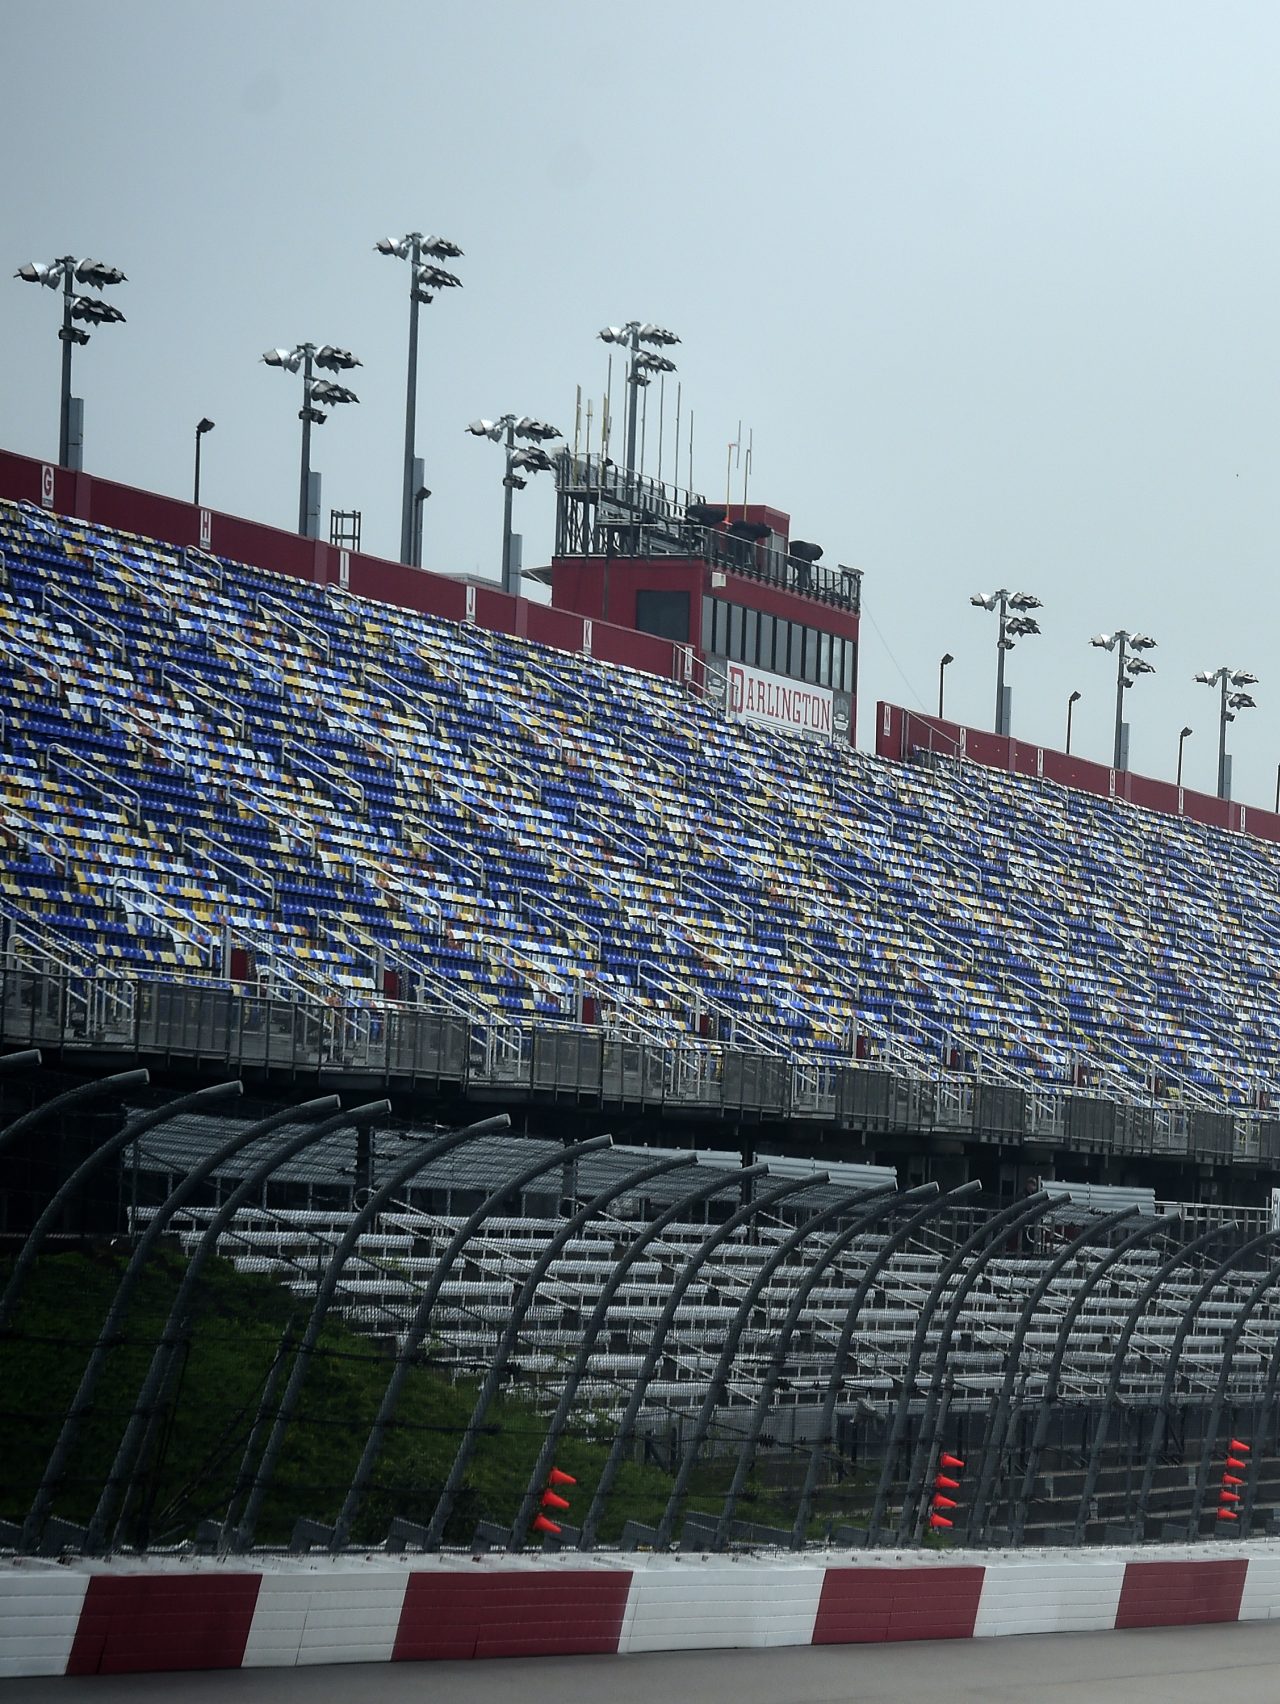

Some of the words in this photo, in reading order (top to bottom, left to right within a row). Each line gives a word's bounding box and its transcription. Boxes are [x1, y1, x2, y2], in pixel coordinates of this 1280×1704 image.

[43, 467, 53, 495] G
[201, 510, 211, 539] H
[467, 587, 475, 613] J
[584, 620, 592, 646] K
[729, 666, 831, 732] DARLINGTON
[884, 707, 890, 728] N
